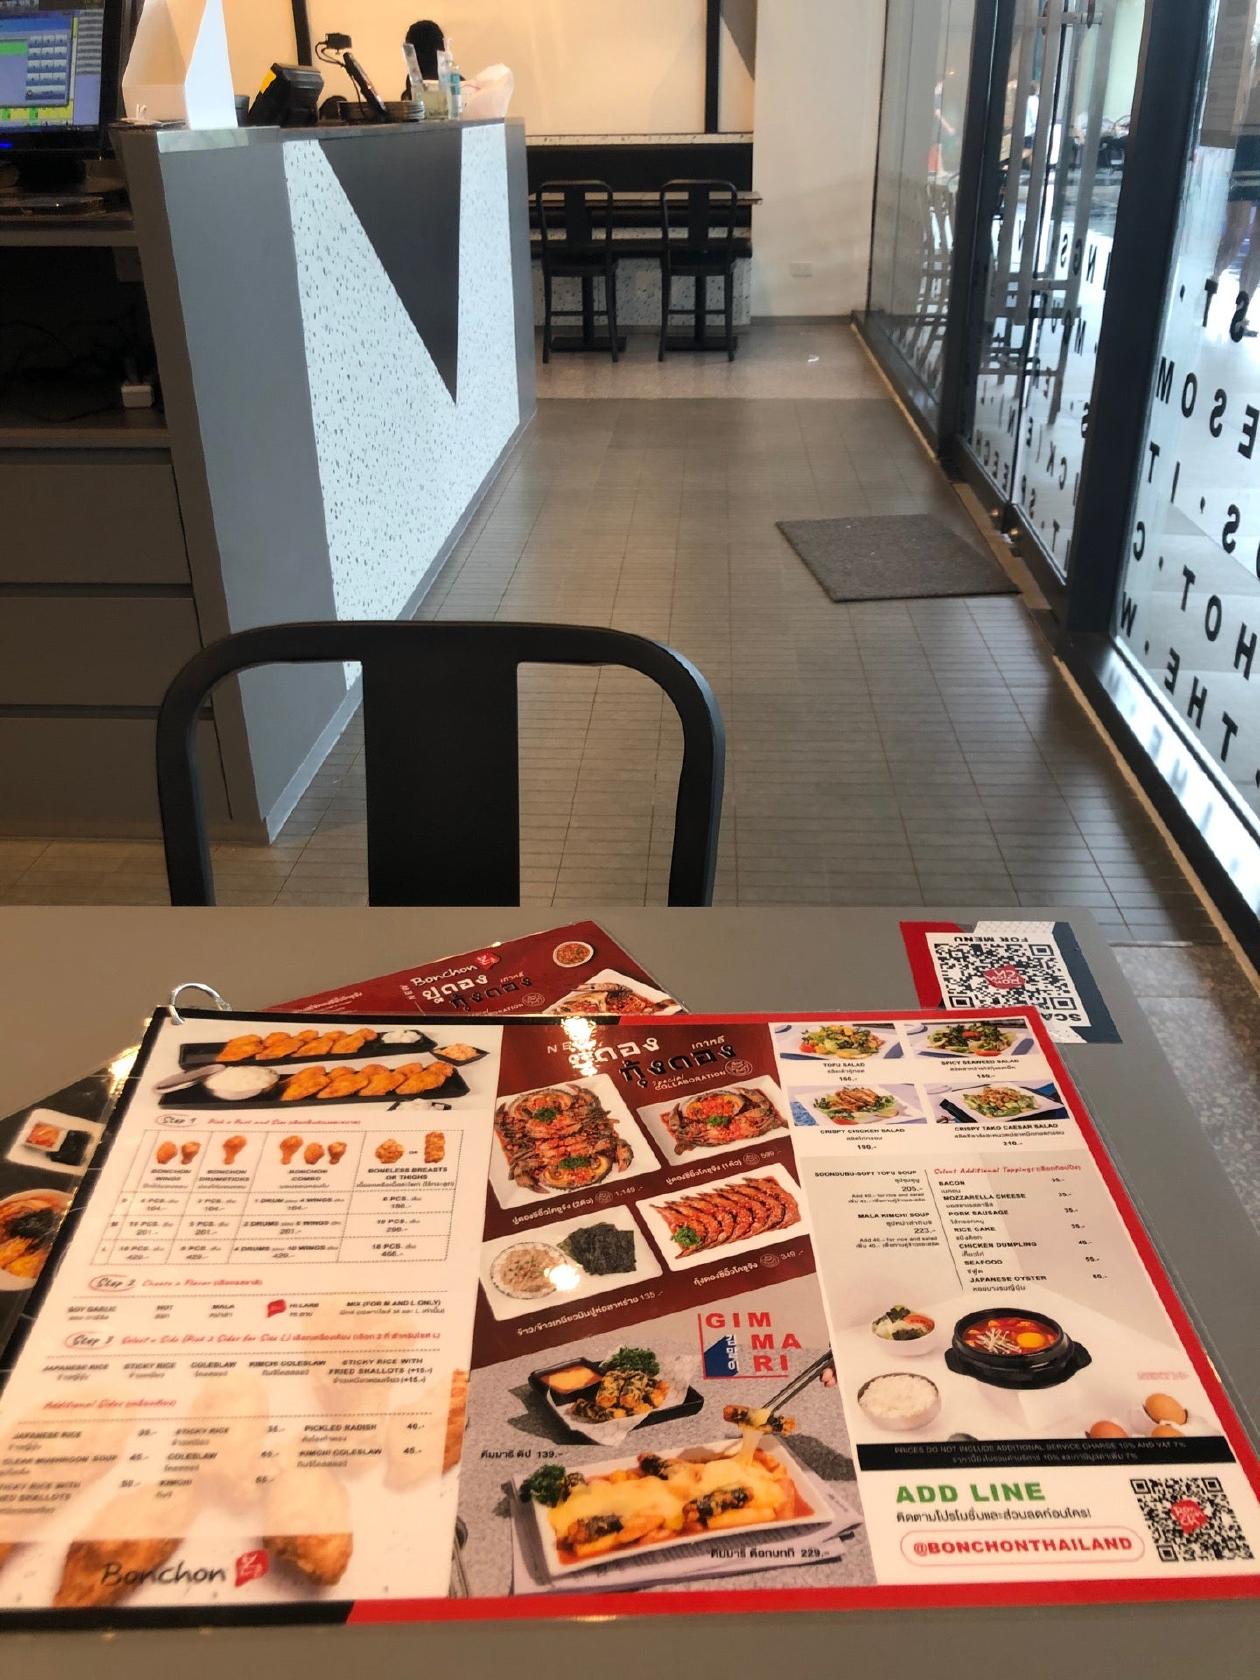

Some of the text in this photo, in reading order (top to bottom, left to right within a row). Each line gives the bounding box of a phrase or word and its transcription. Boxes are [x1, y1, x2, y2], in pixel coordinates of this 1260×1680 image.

[410, 965, 478, 987] Bonchon
[654, 1070, 726, 1091] COLLABORATION
[705, 1311, 772, 1329] GIM
[751, 1333, 802, 1350] MA
[753, 1354, 789, 1373] RI
[537, 1450, 564, 1460] 139.-
[895, 1481, 1046, 1504] ADD LINE
[800, 1547, 831, 1559] 229.-
[912, 1536, 1132, 1557] @BONCHONTHAILAND
[101, 1559, 226, 1587] Bonchon
